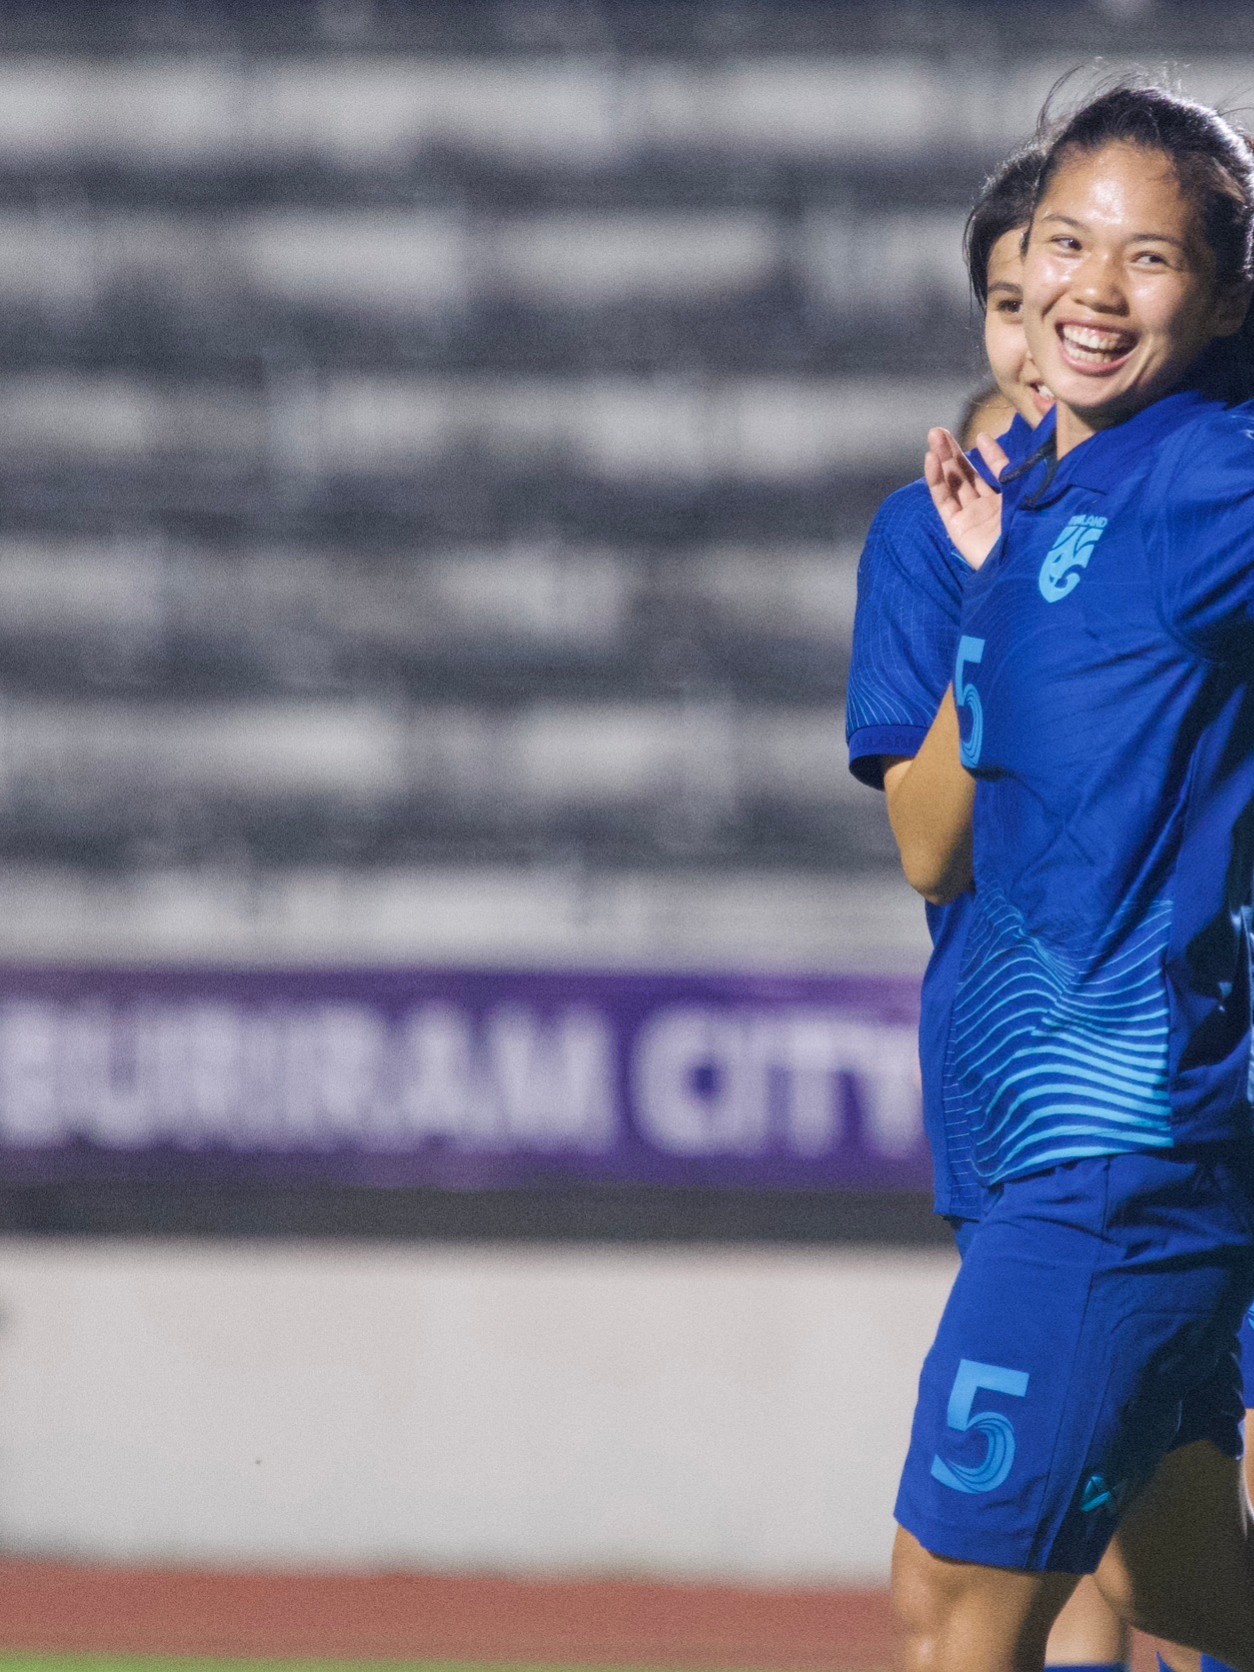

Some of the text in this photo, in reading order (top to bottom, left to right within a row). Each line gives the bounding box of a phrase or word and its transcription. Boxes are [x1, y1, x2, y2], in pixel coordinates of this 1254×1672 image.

[1068, 514, 1108, 528] LAND
[955, 635, 985, 768] 5
[0, 1000, 924, 1155] BURIRAM CITY
[931, 1359, 1030, 1494] 5
